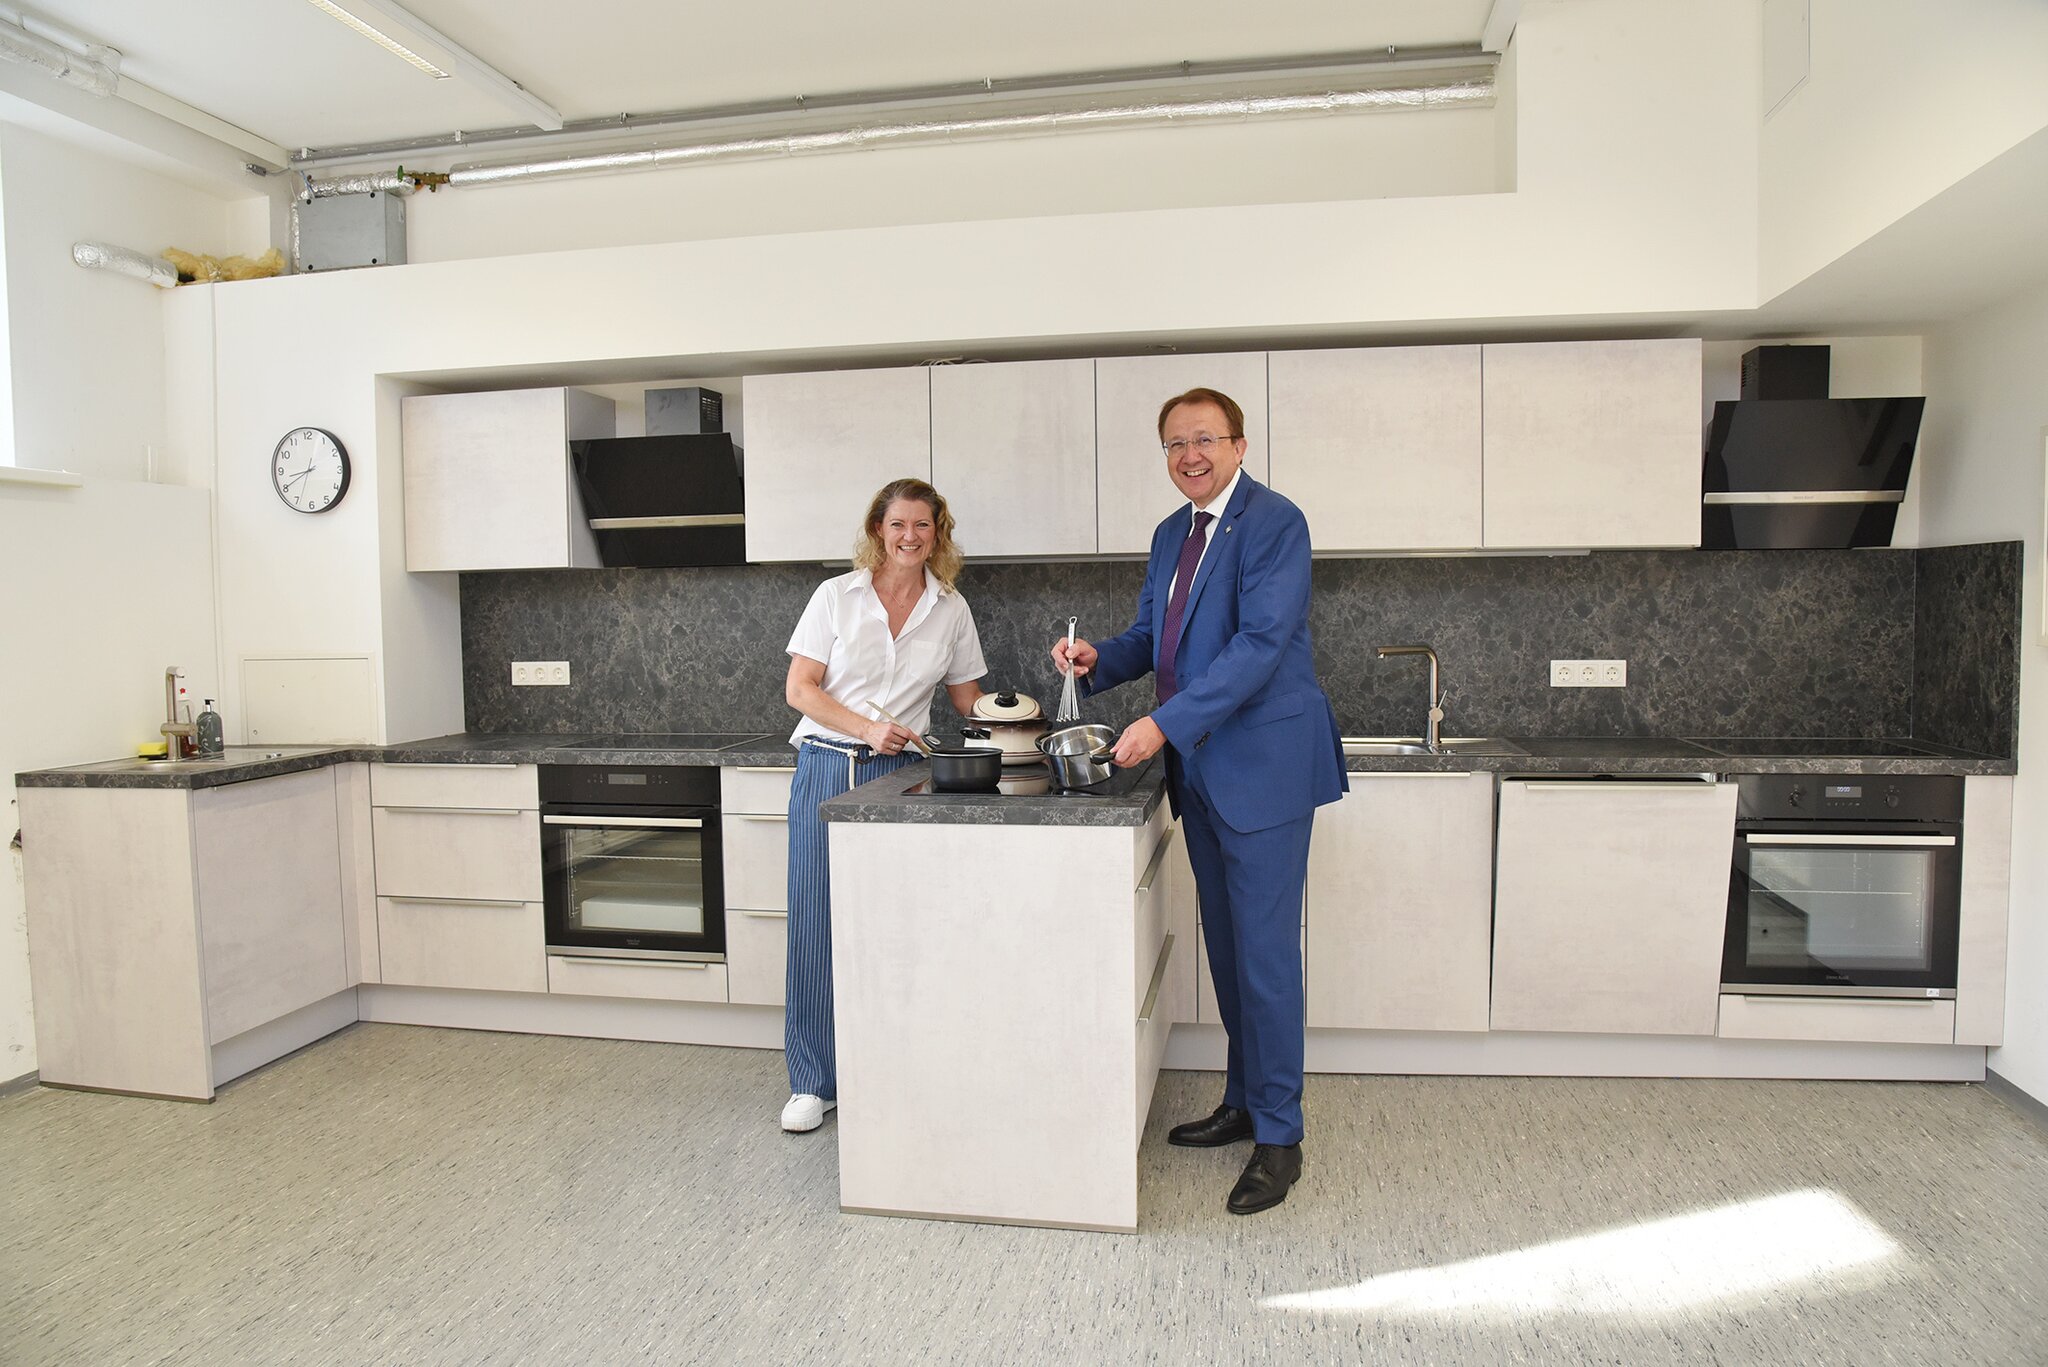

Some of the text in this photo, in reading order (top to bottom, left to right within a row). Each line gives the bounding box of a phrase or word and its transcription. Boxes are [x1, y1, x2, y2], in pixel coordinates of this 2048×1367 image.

[303, 431, 312, 440] 12
[290, 438, 297, 446] 11
[281, 450, 290, 459] 10
[332, 448, 338, 457] 2
[278, 467, 284, 476] 9
[336, 465, 343, 474] 3
[283, 484, 289, 493] 8
[294, 496, 299, 504] 7
[323, 496, 330, 504] 5
[308, 501, 315, 510] 6
